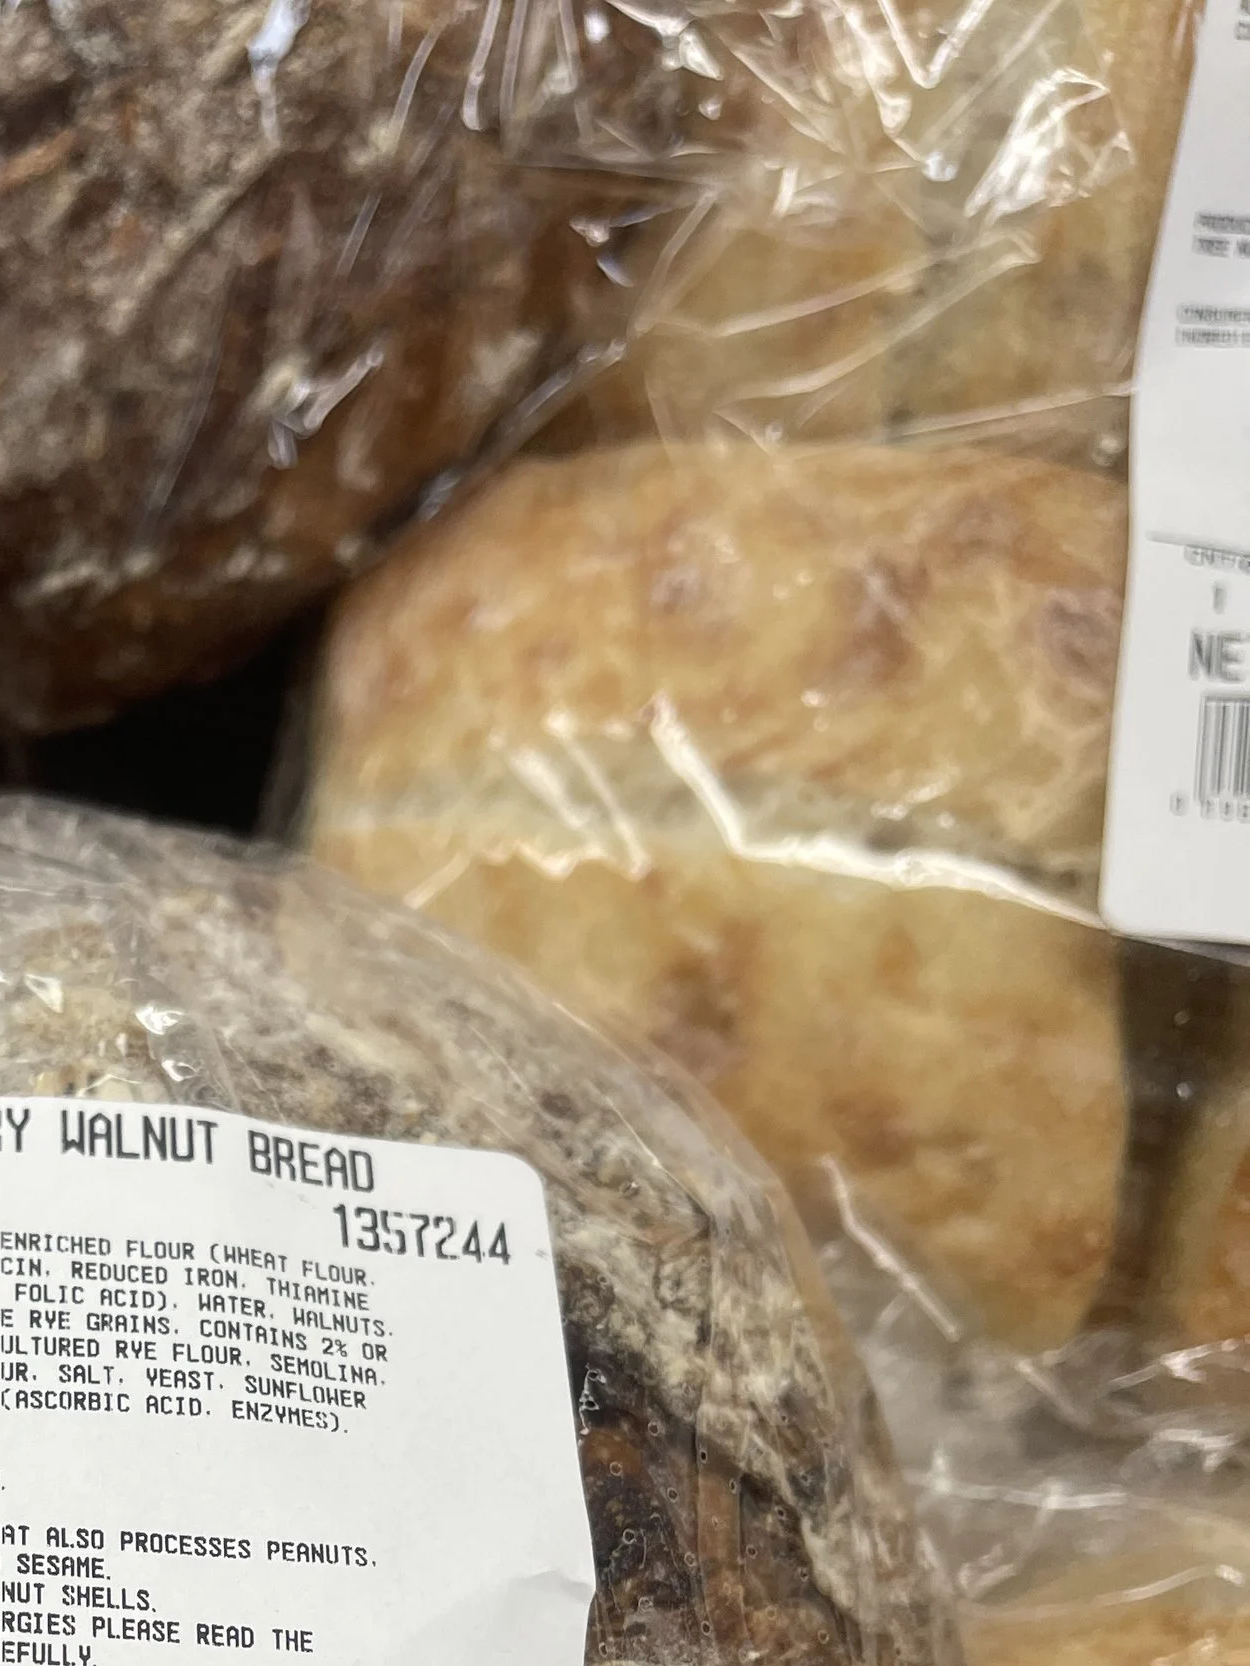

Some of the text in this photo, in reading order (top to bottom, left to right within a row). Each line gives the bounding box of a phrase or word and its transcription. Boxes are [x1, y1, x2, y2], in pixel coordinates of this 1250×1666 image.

[61, 1110, 217, 1164] WALNUT
[249, 1134, 375, 1194] BREAD
[0, 1231, 112, 1257] ENRICHED
[126, 1239, 195, 1261] FLOUR
[332, 1203, 511, 1265] 1357244
[14, 1282, 85, 1305] FOLIC
[70, 1260, 168, 1285] REDUCED
[266, 1276, 370, 1311] THIAMINE
[29, 1309, 71, 1331] RYE
[199, 1318, 308, 1352] CONTAINS
[321, 1336, 348, 1358] 2%
[361, 1342, 388, 1363] OR
[115, 1339, 158, 1361] RYE
[244, 1374, 367, 1410] SUNFLOWER
[46, 1526, 105, 1550] ALSO
[120, 1530, 252, 1560] PROCESSES
[16, 1552, 111, 1581] SESAME.
[61, 1584, 157, 1613] SHELLS.
[91, 1615, 181, 1644] PLEASE
[196, 1622, 255, 1649] READ
[271, 1628, 314, 1653] THE
